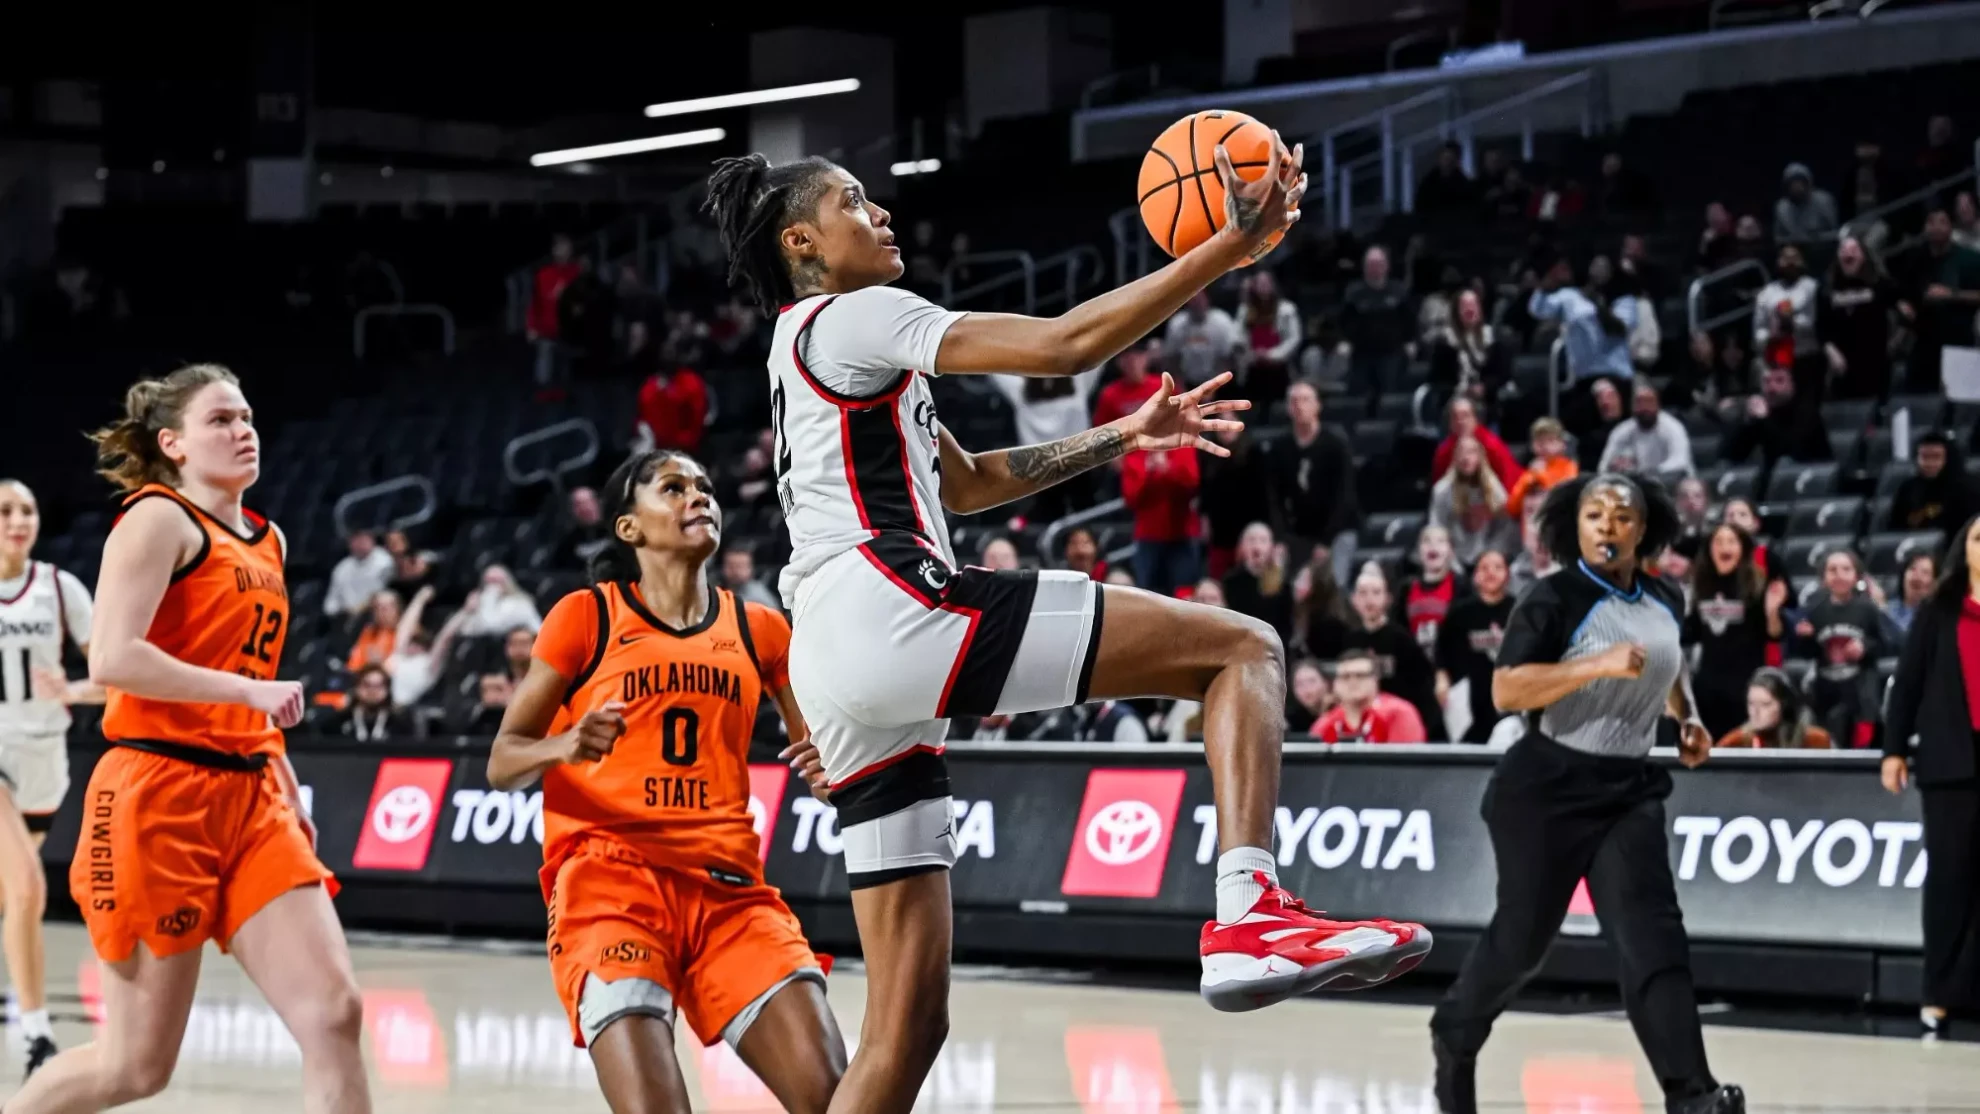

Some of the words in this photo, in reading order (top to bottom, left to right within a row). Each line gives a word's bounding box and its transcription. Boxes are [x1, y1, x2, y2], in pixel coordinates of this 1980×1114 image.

[241, 603, 282, 663] 12
[623, 661, 741, 706] OKLAHOMA
[662, 706, 699, 767] 0
[452, 789, 544, 844] TOY
[644, 777, 710, 810] STATE
[90, 790, 115, 912] COWGIRLS
[1193, 805, 1435, 872] TYOTA
